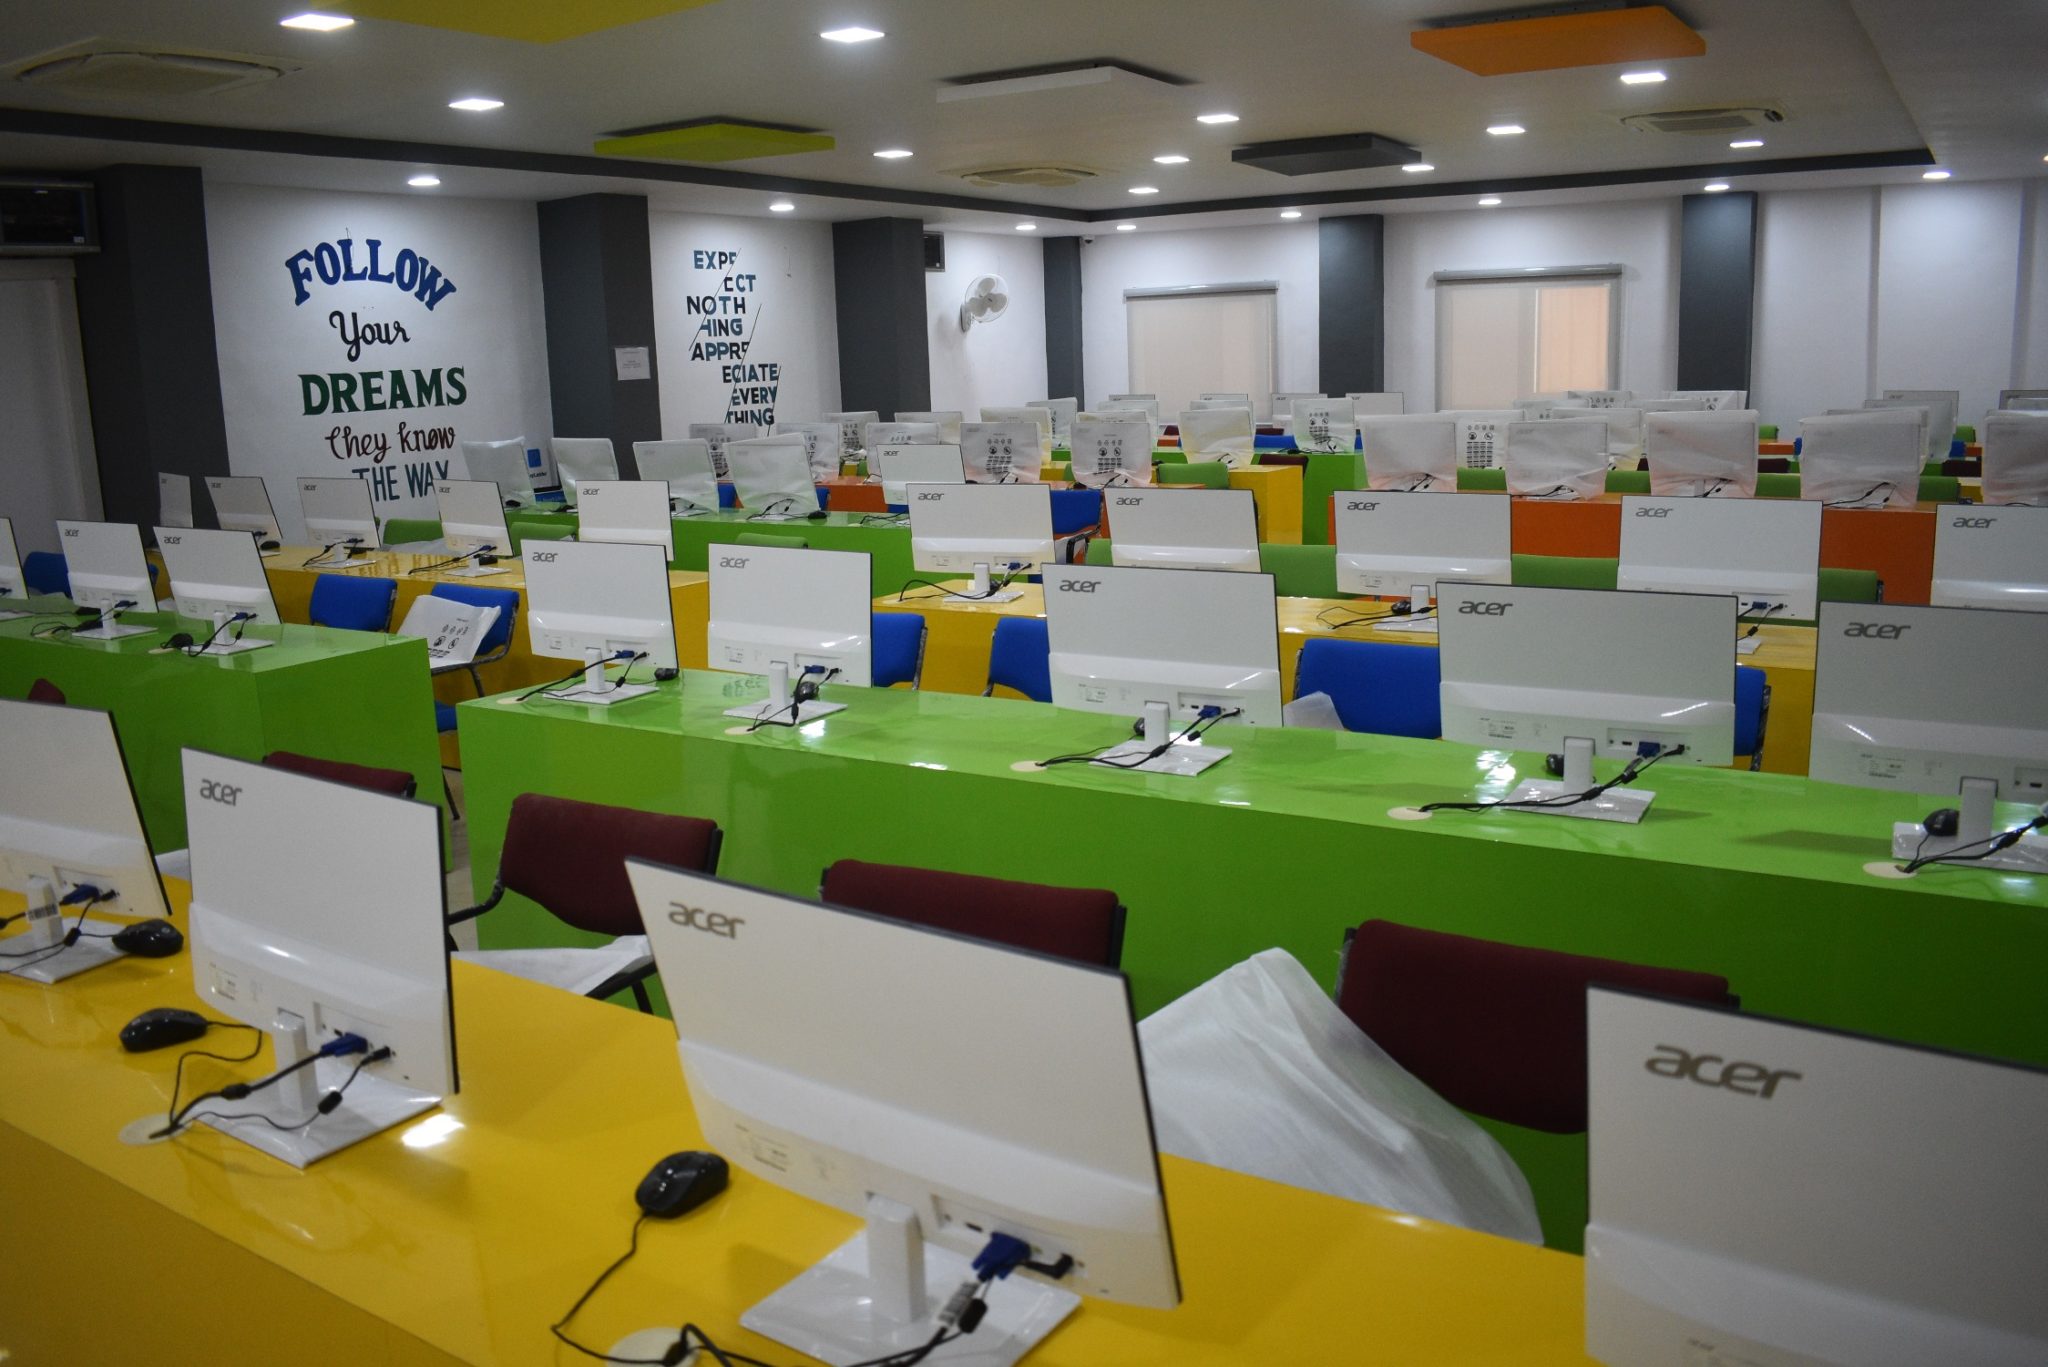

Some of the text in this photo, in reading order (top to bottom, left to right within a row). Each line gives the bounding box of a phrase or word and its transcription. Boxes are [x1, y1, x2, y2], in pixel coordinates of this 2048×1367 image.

[285, 238, 457, 311] FOLLOW
[686, 295, 746, 315] NOTH
[329, 310, 411, 362] Your
[722, 363, 779, 383] ECIATE
[297, 366, 467, 416] DREAMS
[732, 386, 778, 406] EVERY
[726, 407, 775, 427] THING
[397, 421, 456, 453] know
[582, 488, 600, 496] acer
[917, 492, 945, 501] acer
[1115, 497, 1144, 506] acer
[1346, 501, 1381, 511] acer
[1635, 507, 1674, 519] acer
[1952, 517, 1998, 529] acer
[64, 528, 80, 537] acer
[163, 536, 182, 545] acer
[531, 551, 559, 564] acer
[719, 556, 750, 569] acer
[1058, 579, 1102, 594] acer
[1458, 600, 1514, 617] acer
[1843, 621, 1912, 641] acer
[199, 778, 243, 807] acer
[667, 901, 746, 940] acer
[1645, 1044, 1803, 1100] acer
